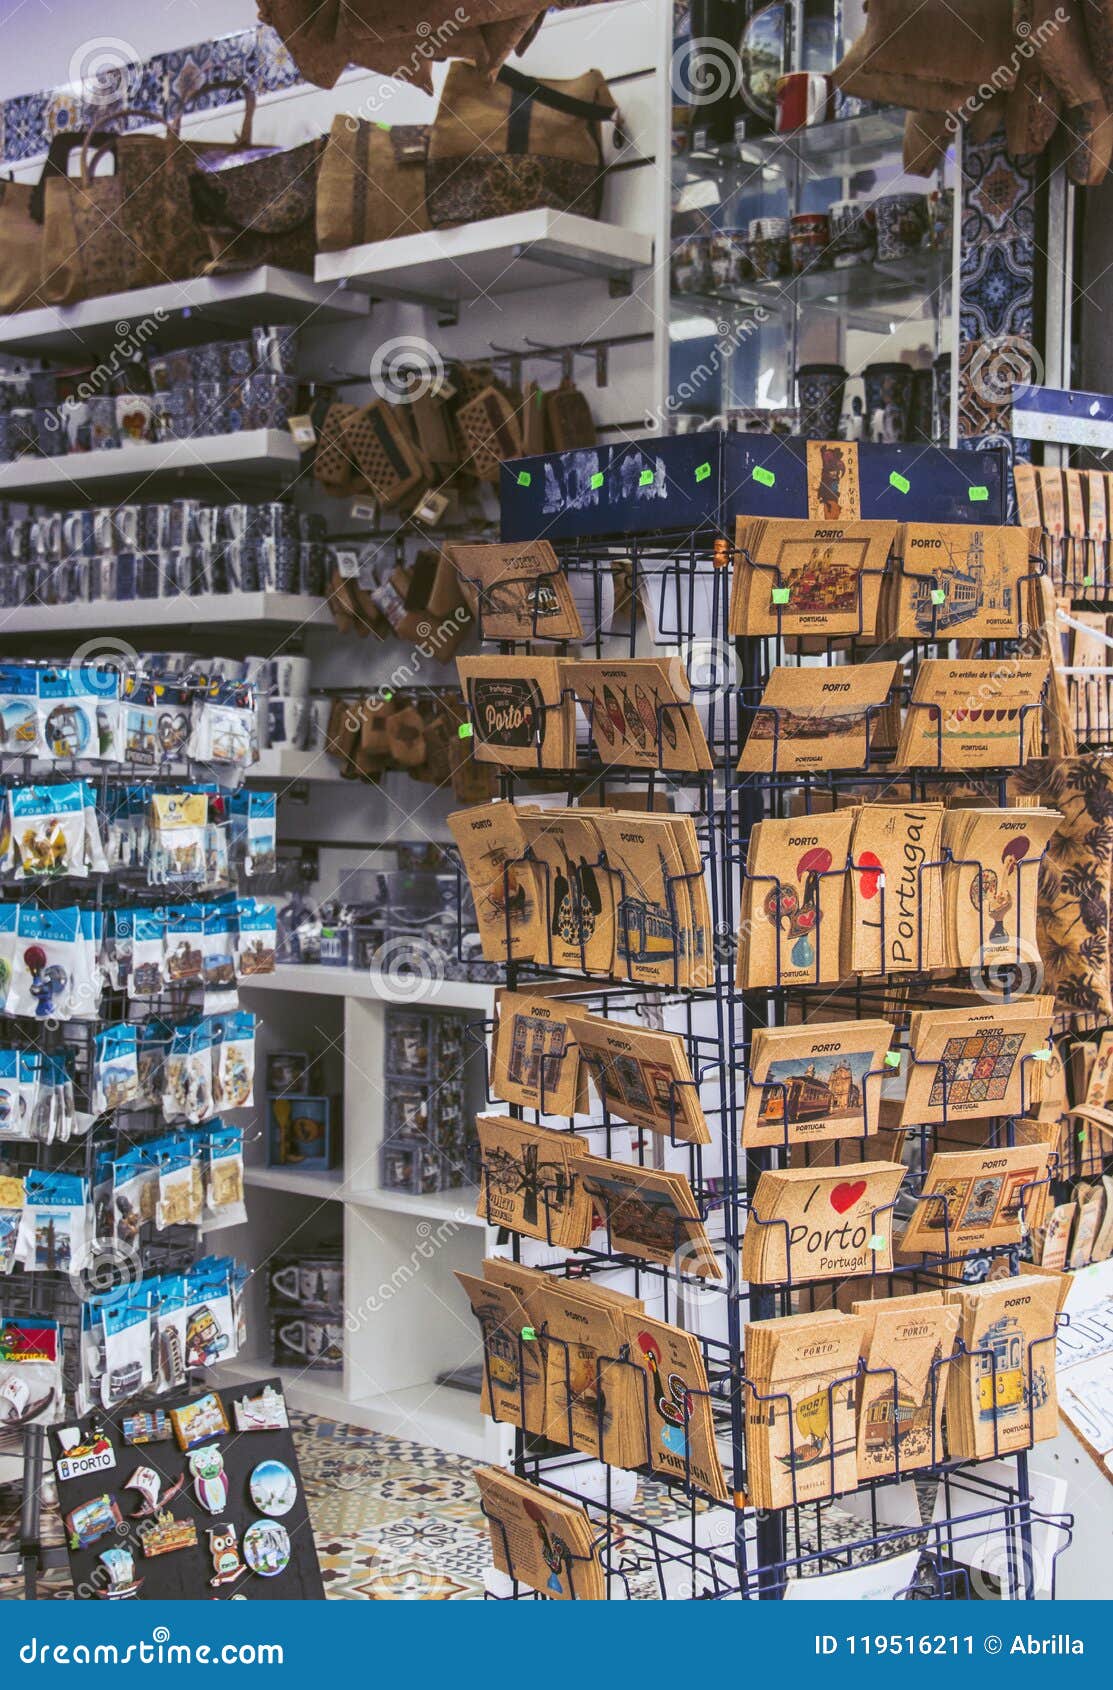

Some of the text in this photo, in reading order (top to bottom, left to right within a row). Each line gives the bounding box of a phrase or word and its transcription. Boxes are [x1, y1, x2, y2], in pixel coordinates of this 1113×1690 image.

[814, 530, 844, 539] PORTO
[911, 539, 942, 549] PORTO
[822, 683, 851, 692] PORTO
[486, 704, 523, 733] Porto
[471, 819, 493, 831] PORTO
[999, 822, 1027, 831] PORTO
[620, 833, 645, 844] PORTO
[788, 837, 819, 847] PORTO
[892, 812, 927, 964] Portugal
[635, 965, 661, 975] PORTUGAL
[530, 1006, 551, 1018] PORTO
[976, 1027, 1004, 1037] PORTO
[811, 1042, 842, 1053] PORTO
[796, 1123, 827, 1131] PORTUGAL
[981, 1159, 1008, 1169] PORTO
[802, 1184, 821, 1214] I
[788, 1221, 868, 1254] Porto
[820, 1252, 868, 1271] Portugal
[1004, 1296, 1032, 1308] PORTO
[902, 1325, 929, 1337] PORTO
[803, 1344, 833, 1357] PORTO
[5, 1352, 49, 1361] PORTUGAL
[799, 1396, 827, 1413] PORT
[71, 1455, 111, 1473] PORTO
